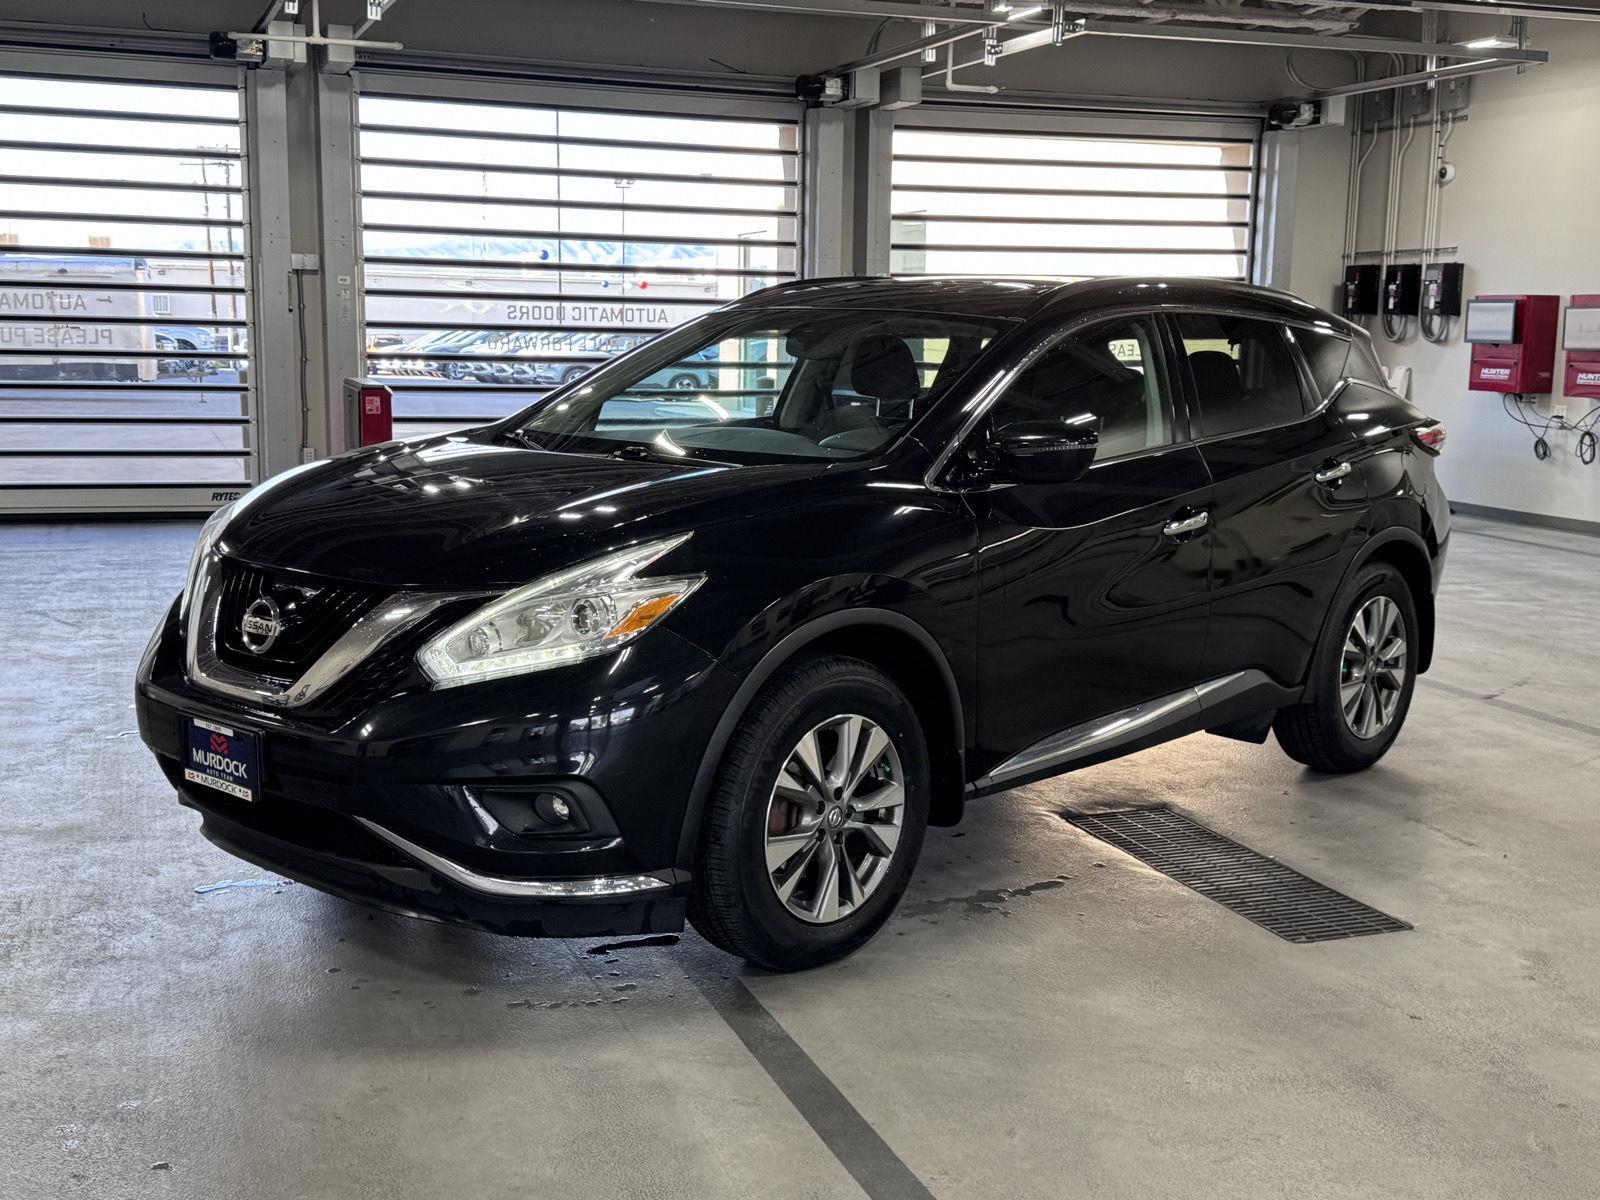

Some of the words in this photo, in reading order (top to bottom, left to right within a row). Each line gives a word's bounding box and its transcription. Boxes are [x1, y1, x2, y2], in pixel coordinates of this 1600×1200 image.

[1480, 367, 1511, 377] HUNTER
[211, 491, 241, 501] RYTEC
[244, 618, 273, 634] SSAN
[192, 747, 248, 779] MURDOCK
[200, 775, 237, 795] MURDOCK
